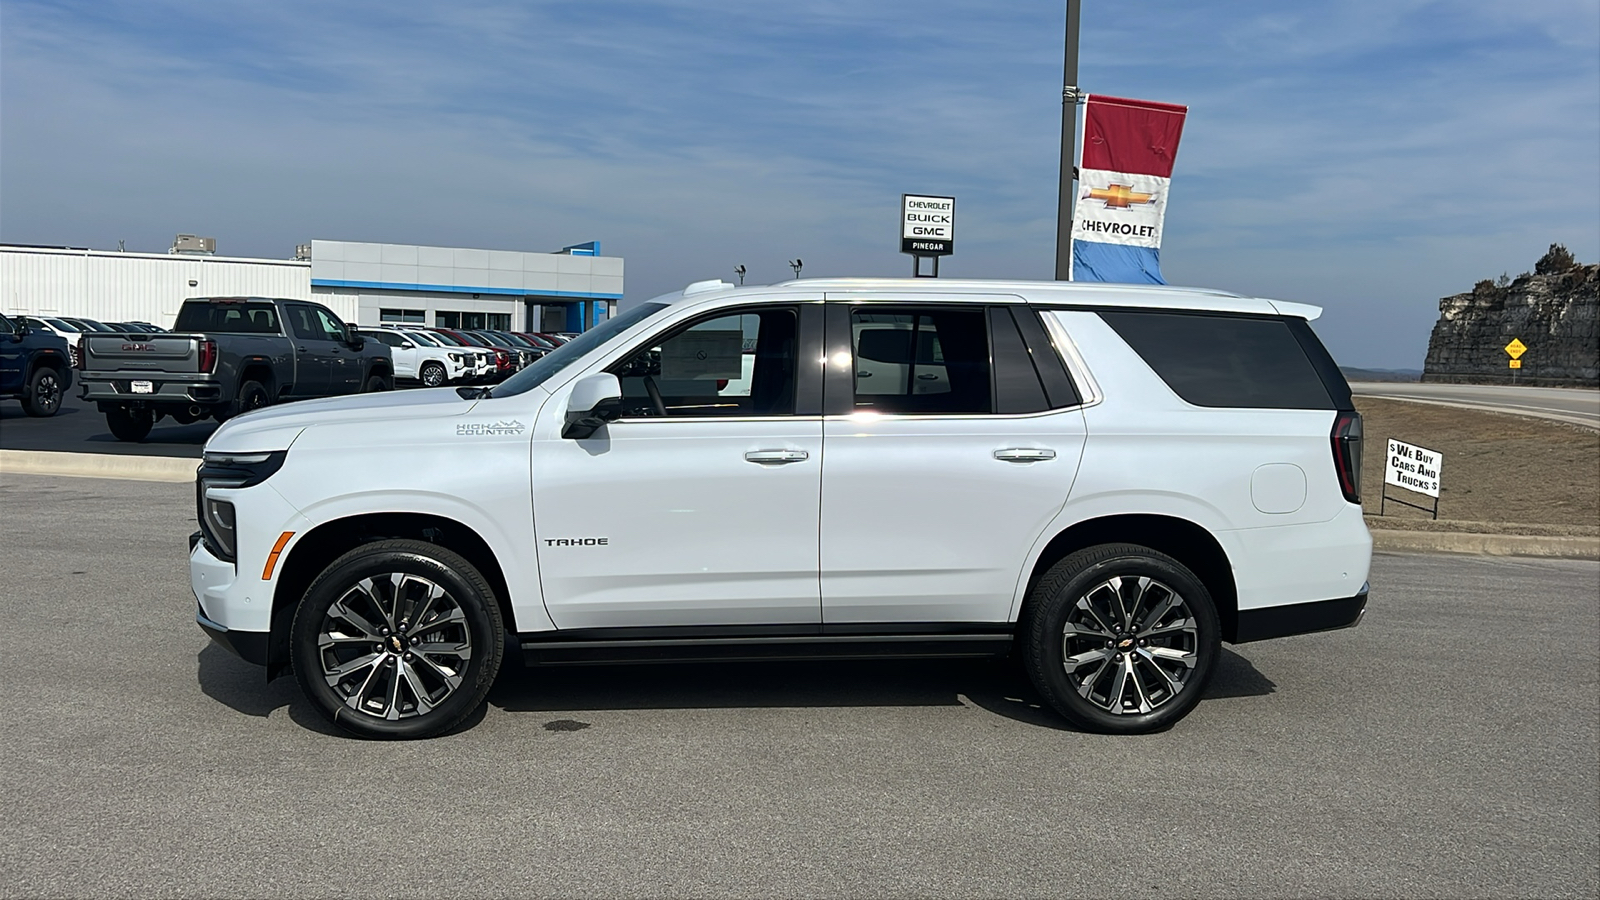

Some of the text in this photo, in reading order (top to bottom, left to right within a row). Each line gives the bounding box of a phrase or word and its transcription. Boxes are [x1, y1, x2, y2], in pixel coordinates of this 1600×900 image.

[908, 200, 951, 210] CHEVROLET
[907, 213, 950, 223] BUICK
[912, 226, 945, 236] GMC
[1081, 219, 1155, 238] CHEVROLET
[912, 242, 944, 250] PINEGAR
[121, 343, 156, 352] GMC
[544, 538, 609, 547] TAHOE
